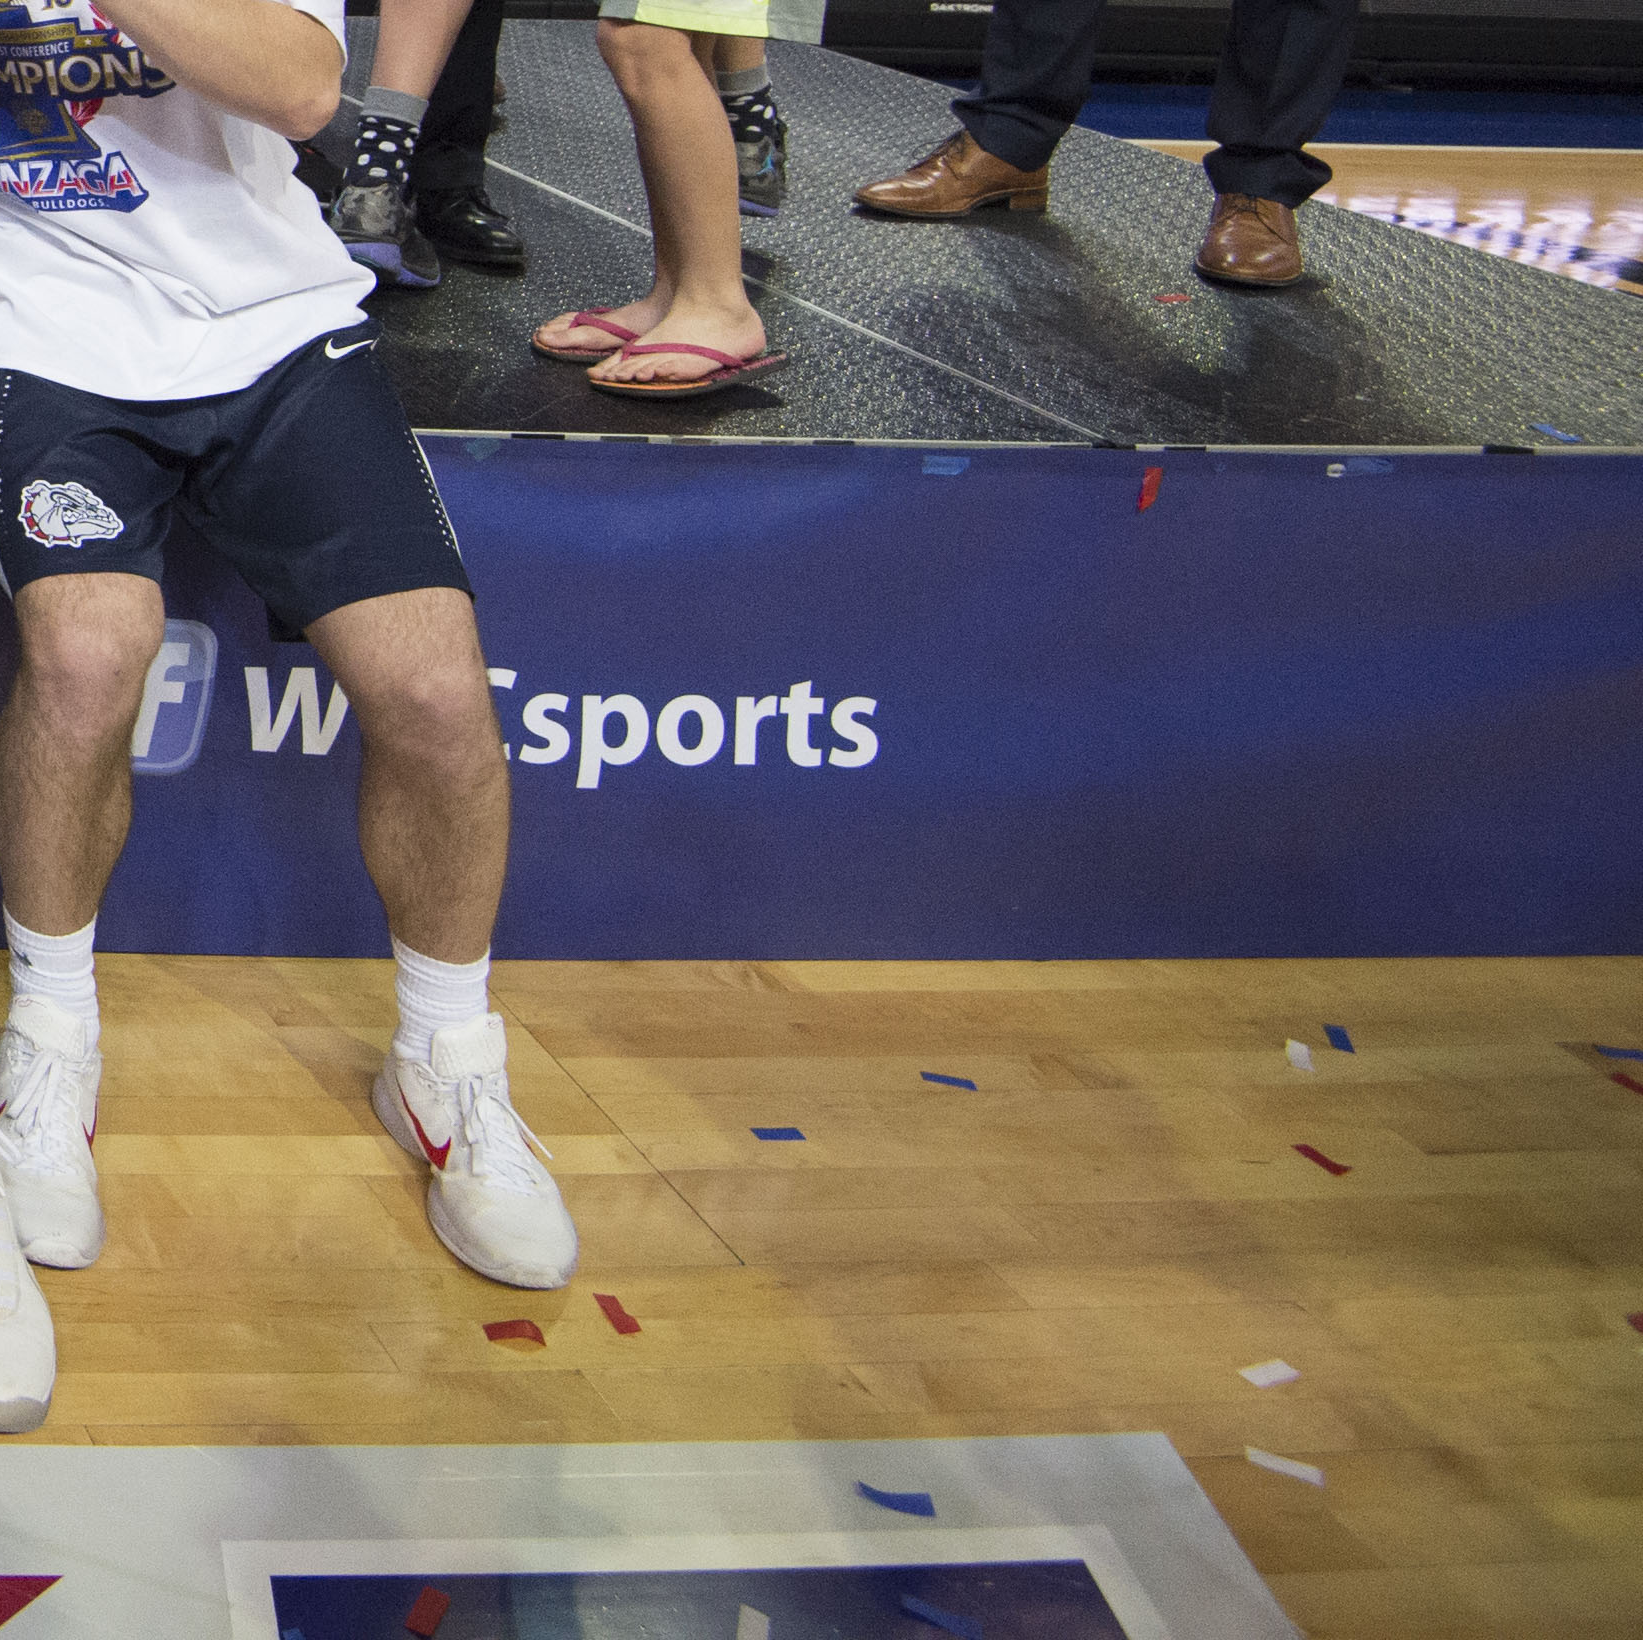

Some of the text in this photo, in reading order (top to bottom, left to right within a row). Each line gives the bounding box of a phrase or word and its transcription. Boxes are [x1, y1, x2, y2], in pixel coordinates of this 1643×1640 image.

[11, 42, 69, 57] CONFERENCE
[32, 197, 104, 210] BULLDOGS
[244, 665, 878, 790] Wsports
